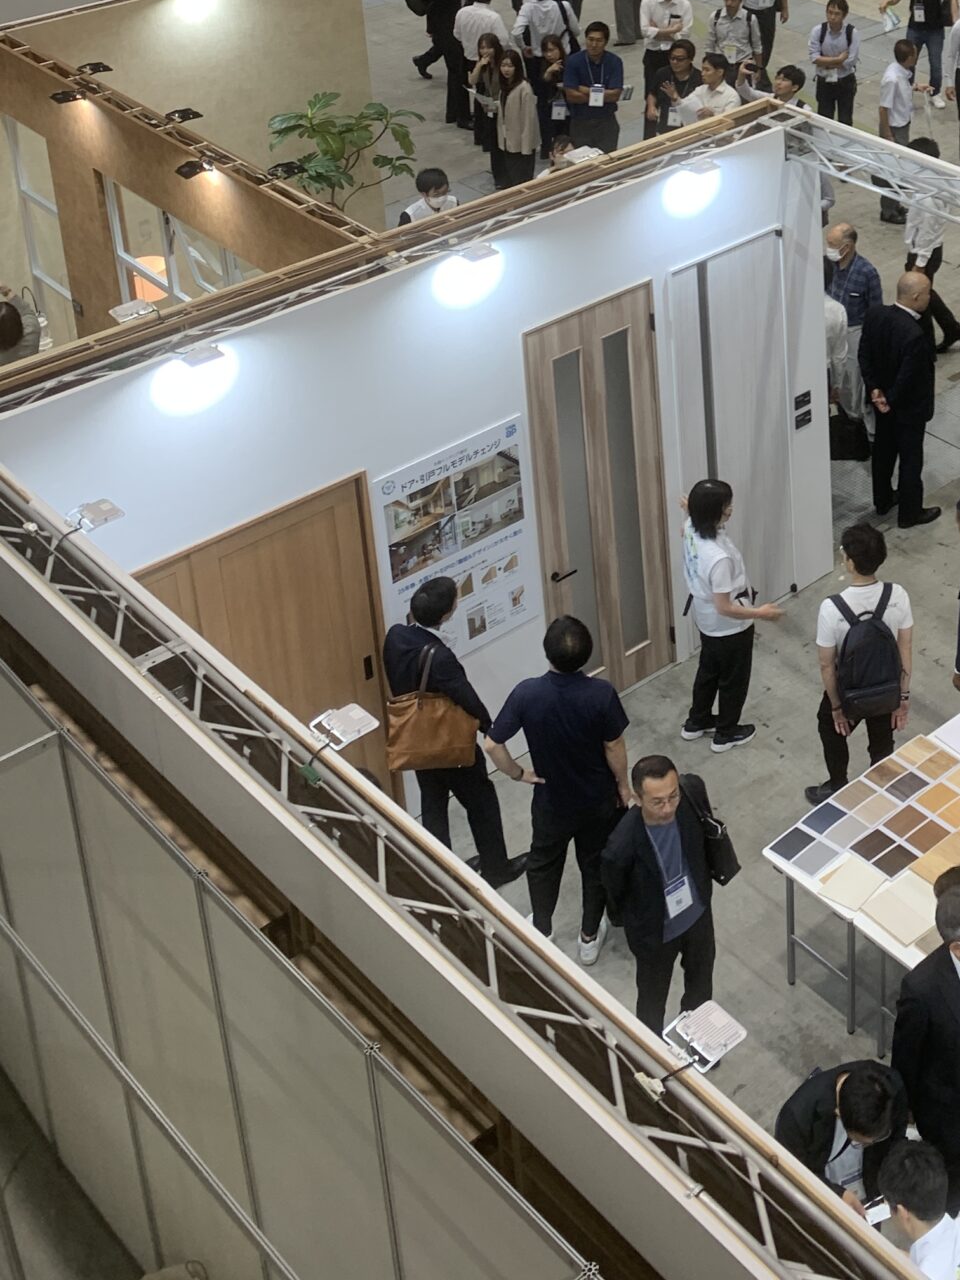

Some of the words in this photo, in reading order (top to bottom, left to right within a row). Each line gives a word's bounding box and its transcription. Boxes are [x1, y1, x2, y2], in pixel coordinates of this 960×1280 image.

[401, 439, 502, 493] ドア・引戸フルモデルチェンジ
